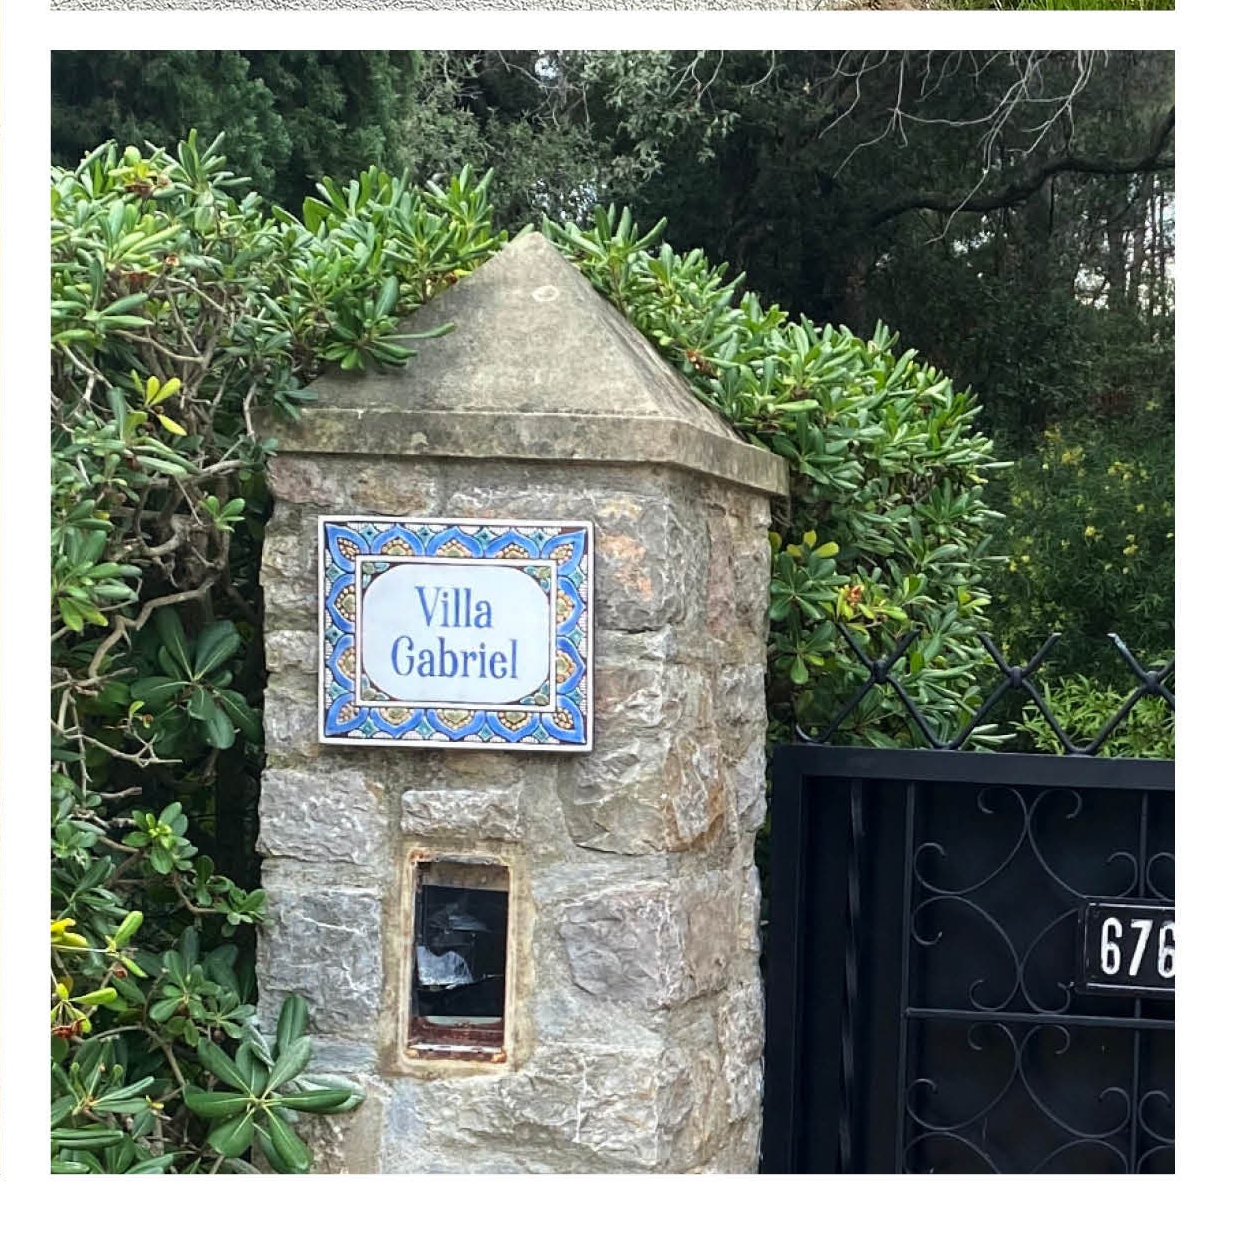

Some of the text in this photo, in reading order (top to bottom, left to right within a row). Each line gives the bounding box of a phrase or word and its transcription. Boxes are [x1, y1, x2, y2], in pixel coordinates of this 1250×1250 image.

[414, 585, 493, 629] Villa
[391, 635, 518, 680] Gabriel
[1101, 917, 1175, 979] 676
